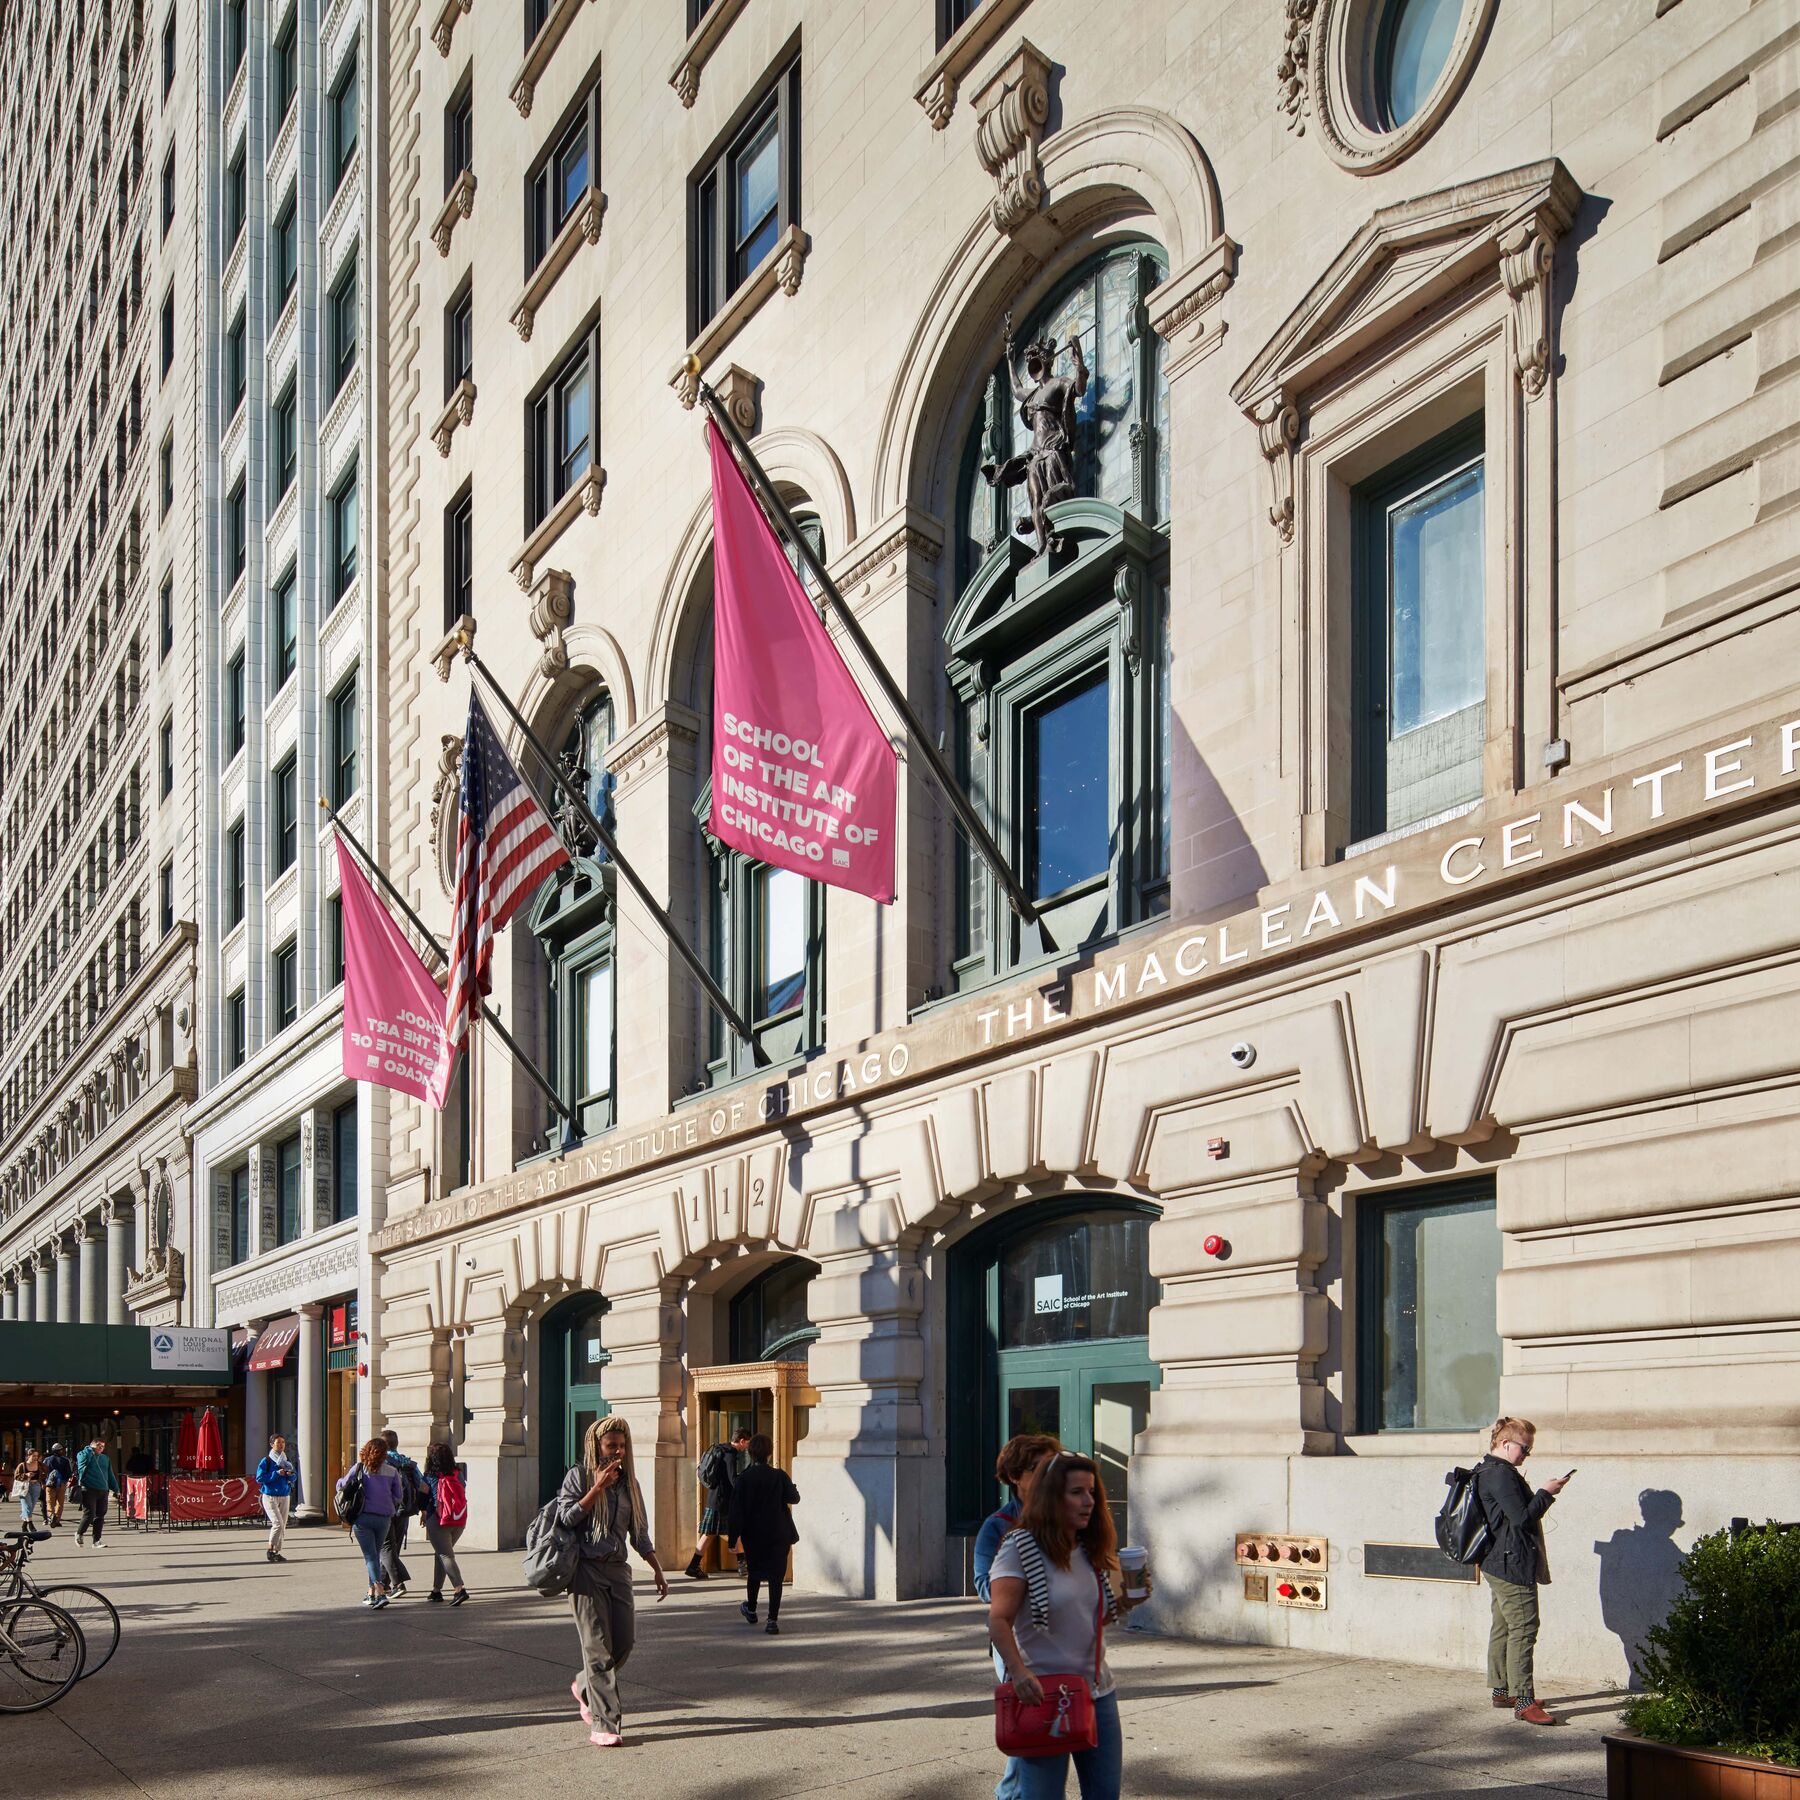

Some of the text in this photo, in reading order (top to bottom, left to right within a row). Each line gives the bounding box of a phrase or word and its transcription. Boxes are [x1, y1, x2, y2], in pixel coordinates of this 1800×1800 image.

[723, 712, 824, 768] SCHOOL
[723, 744, 856, 814] OF THE ART
[721, 804, 824, 861] CHICAGO
[722, 773, 879, 846] INSTITUTE OF
[977, 985, 1067, 1044] THE
[1094, 866, 1396, 1008] MACLEAN
[377, 1043, 909, 1245] THE SCHOOL OF THE ART INSTITUTE OF CHICAGO
[1037, 1298, 1060, 1311] SAIC
[1063, 1295, 1080, 1303] School
[1106, 1290, 1128, 1298] Institute
[1070, 1301, 1090, 1309] Chicago
